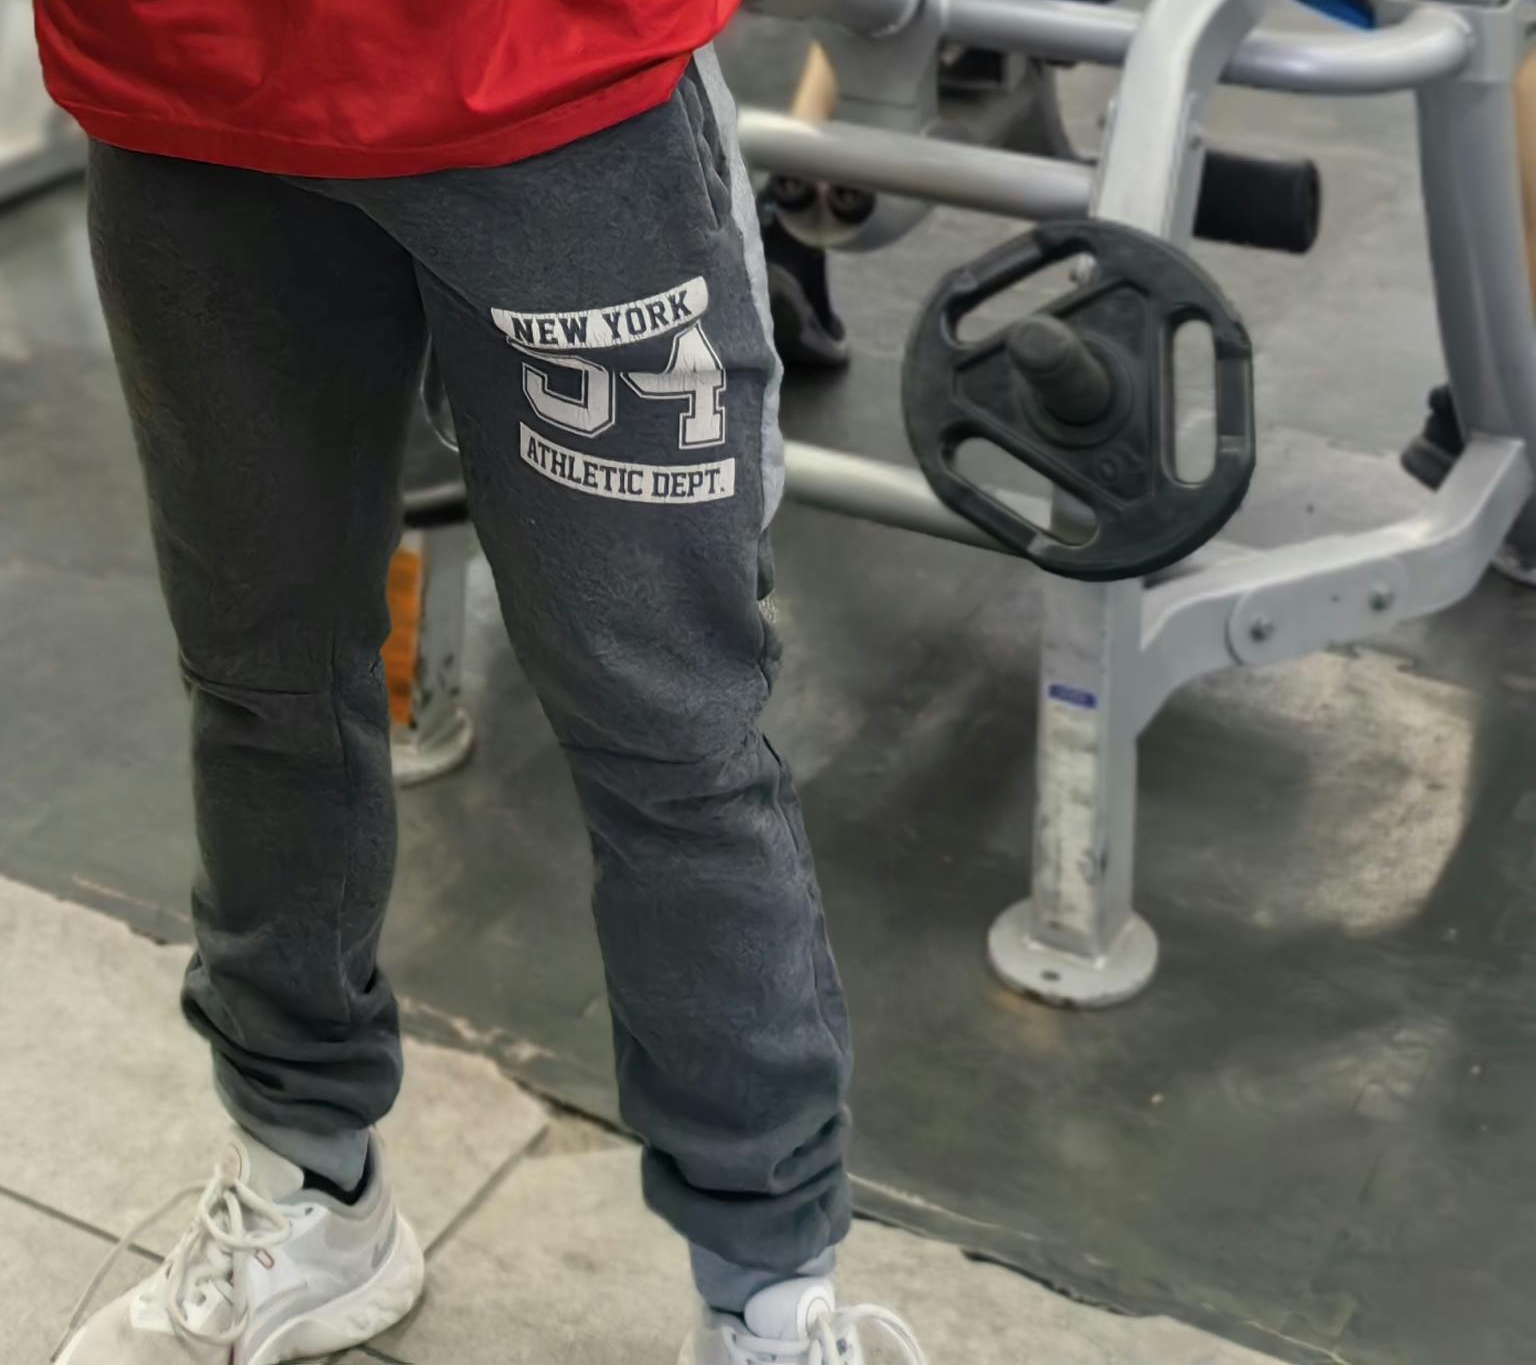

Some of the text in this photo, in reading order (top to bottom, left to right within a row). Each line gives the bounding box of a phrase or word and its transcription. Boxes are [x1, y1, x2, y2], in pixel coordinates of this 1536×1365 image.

[511, 289, 693, 346] NEW YORK
[526, 435, 726, 499] ATHLETIC DEPT.
